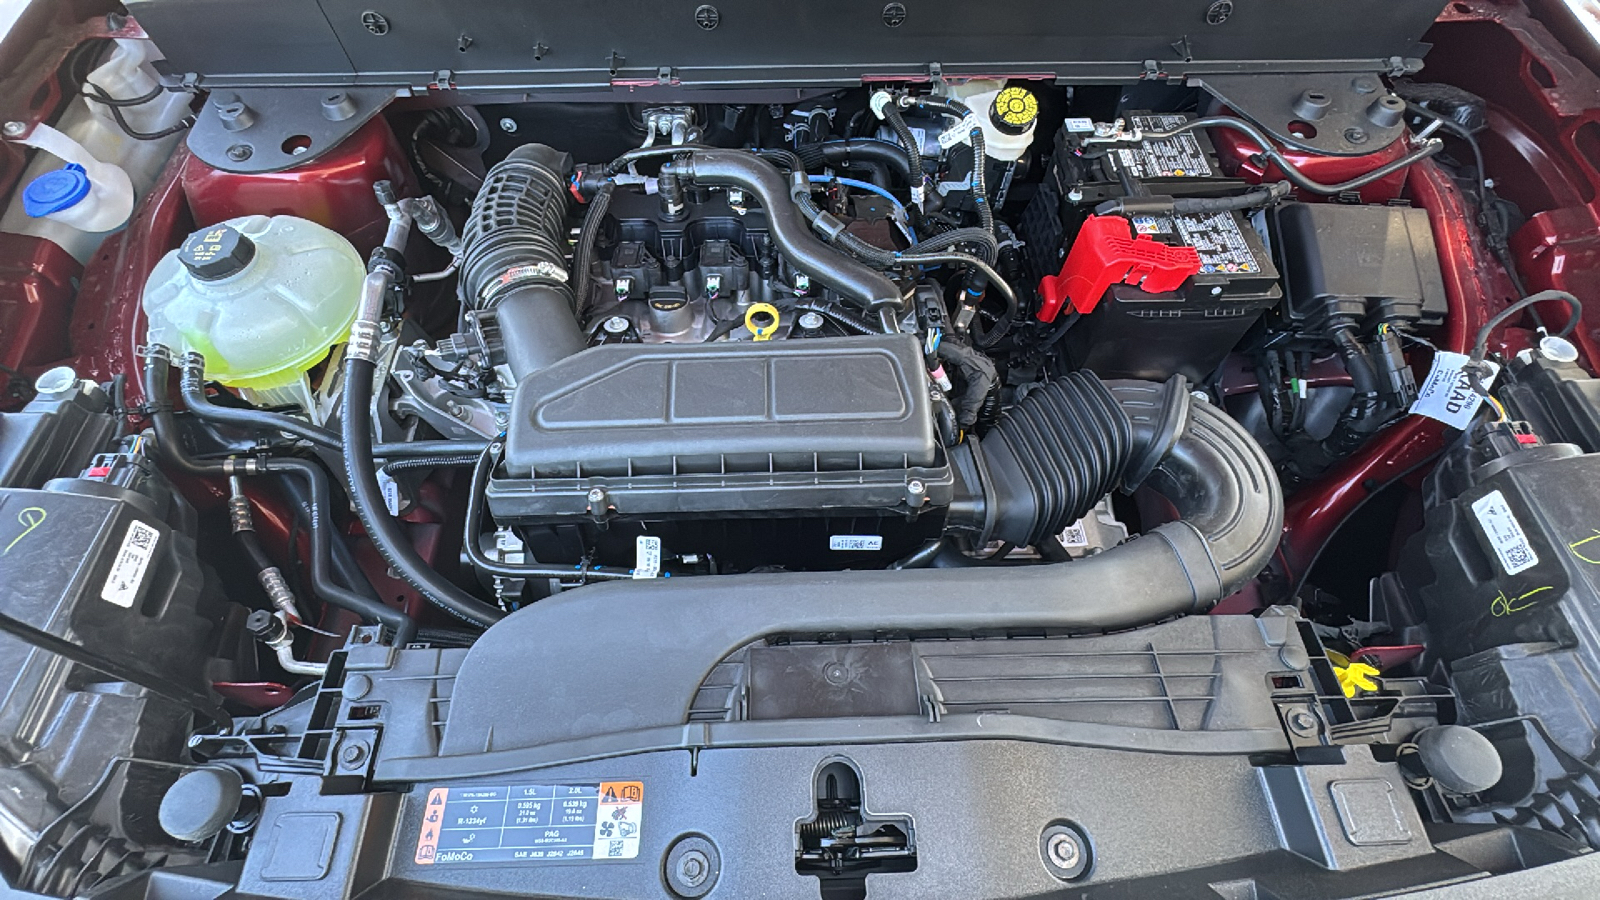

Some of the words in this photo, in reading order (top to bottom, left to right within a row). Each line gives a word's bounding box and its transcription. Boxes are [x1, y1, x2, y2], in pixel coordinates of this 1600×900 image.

[524, 788, 537, 796] 1.5L
[533, 802, 541, 810] kg
[579, 800, 587, 809] kg
[435, 851, 473, 861] FoMoCo
